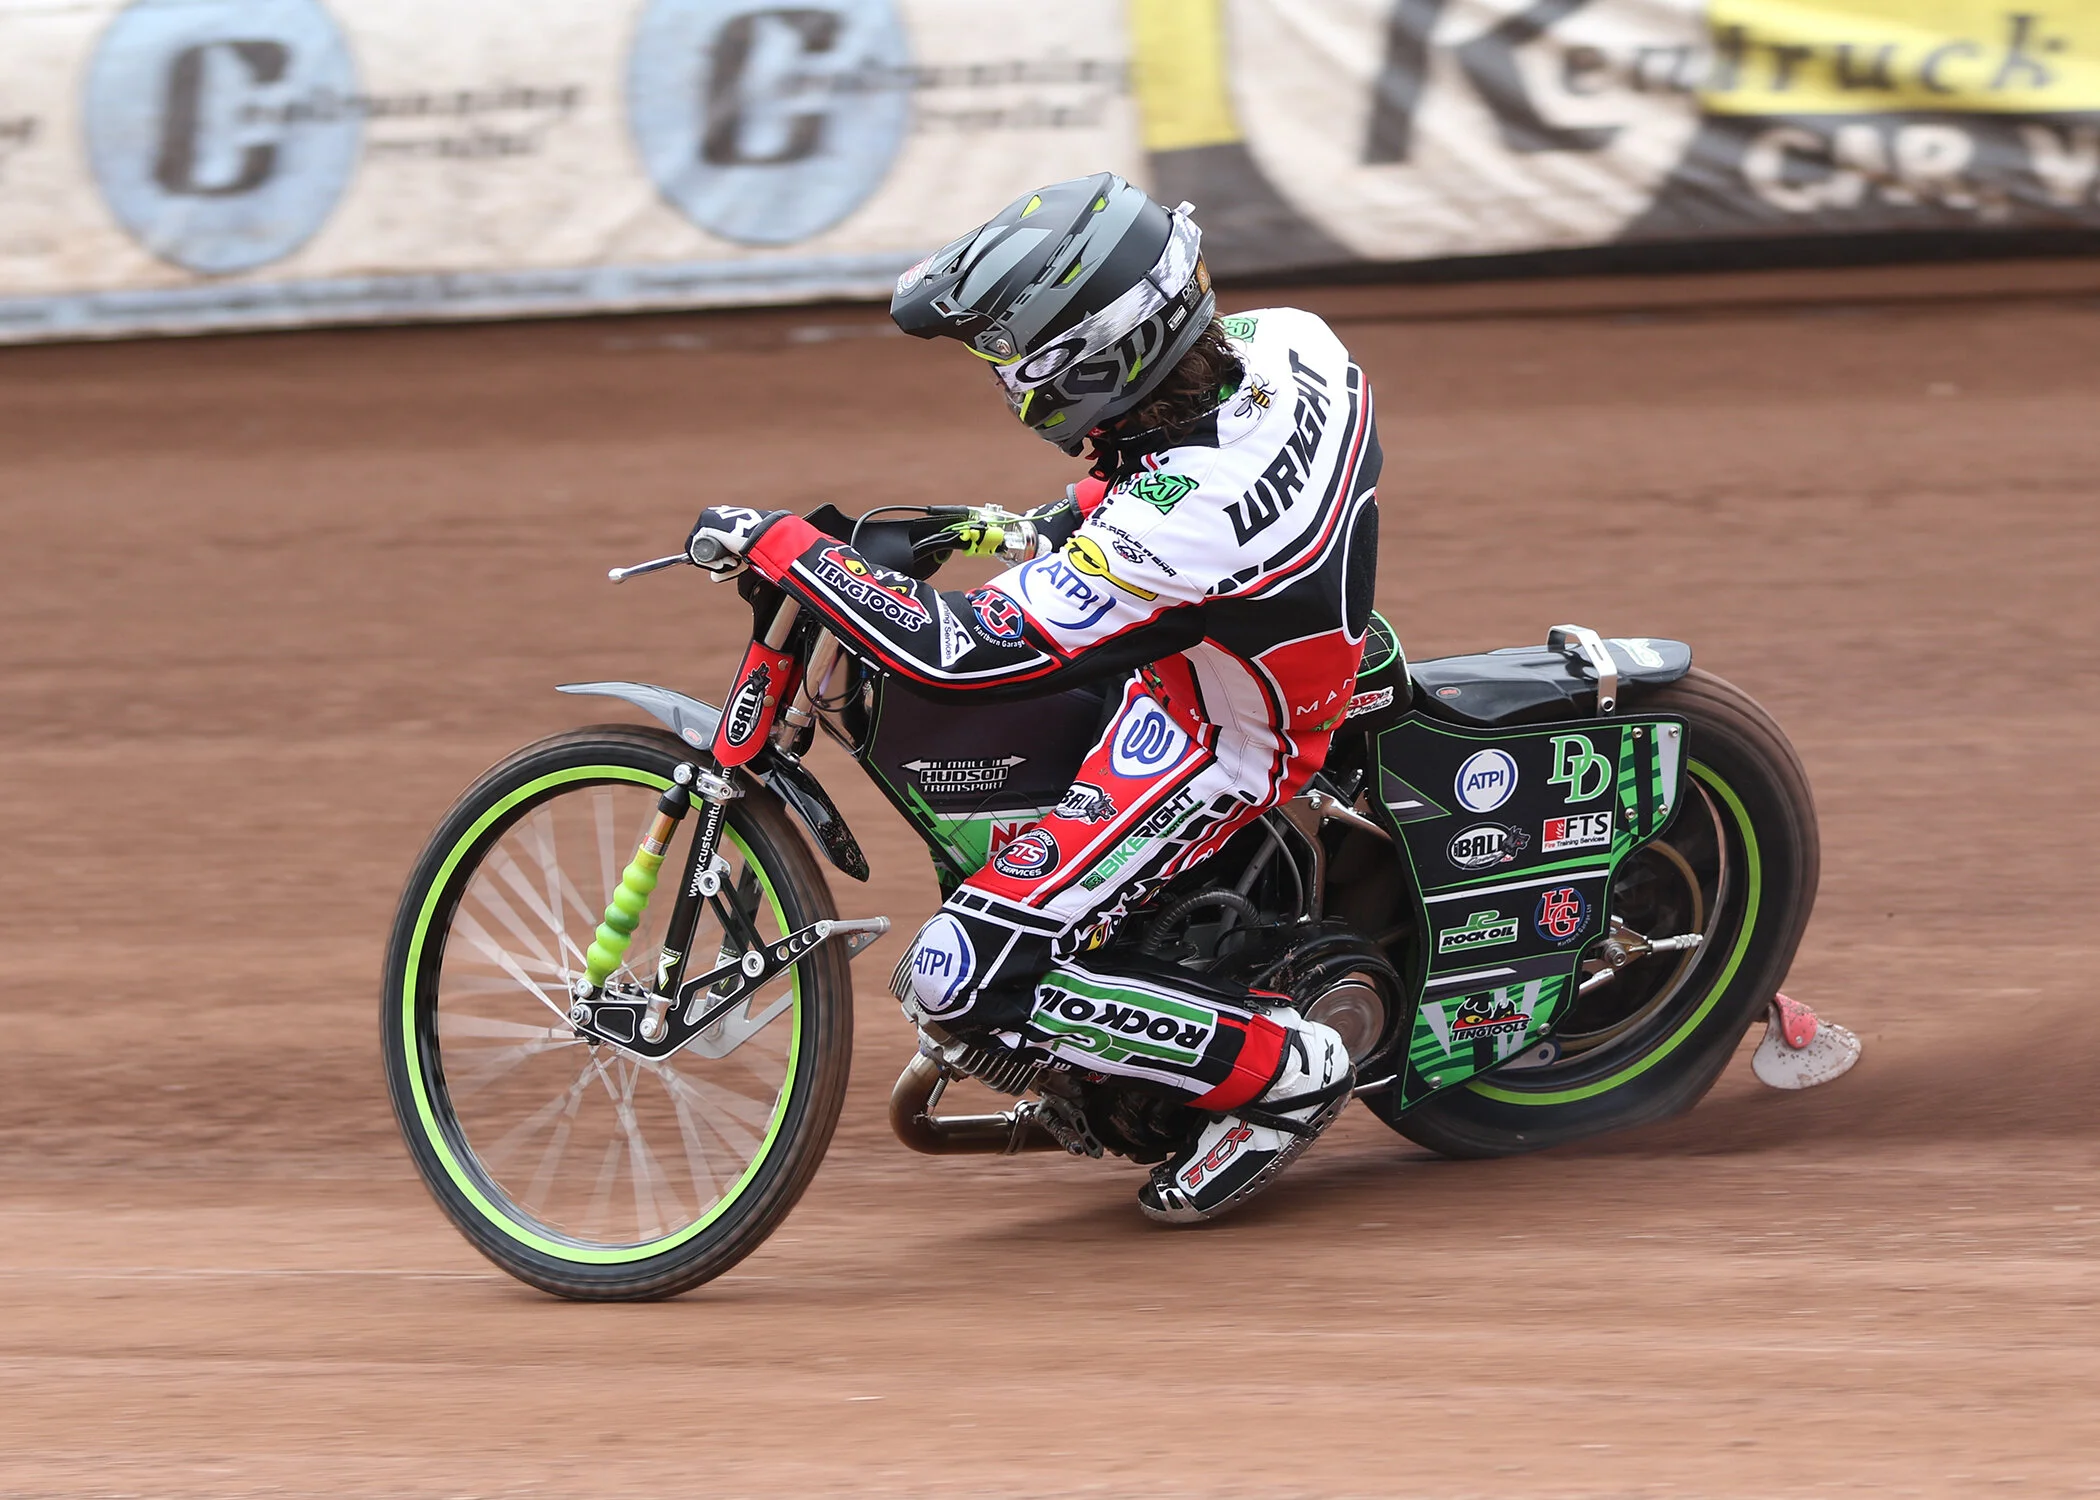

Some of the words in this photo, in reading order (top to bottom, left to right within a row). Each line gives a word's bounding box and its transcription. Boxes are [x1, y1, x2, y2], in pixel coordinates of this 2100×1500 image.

[1181, 275, 1199, 300] DOT
[1222, 348, 1331, 547] WRIGHT
[1036, 559, 1100, 612] ATPI
[943, 626, 952, 660] Services
[973, 624, 1001, 647] Hartburn
[1001, 639, 1026, 648] Garage
[920, 766, 1010, 784] HUDSON
[923, 781, 1003, 793] TRANSPORT
[1466, 770, 1504, 792] ATPI
[1565, 813, 1608, 839] FTS
[1557, 838, 1579, 848] Training
[1580, 835, 1605, 844] Services
[1001, 865, 1043, 877] SERVICES
[1442, 930, 1491, 947] ROCK
[1488, 925, 1515, 939] OIL
[913, 945, 953, 977] ATPI
[1091, 1003, 1209, 1050] ROCK
